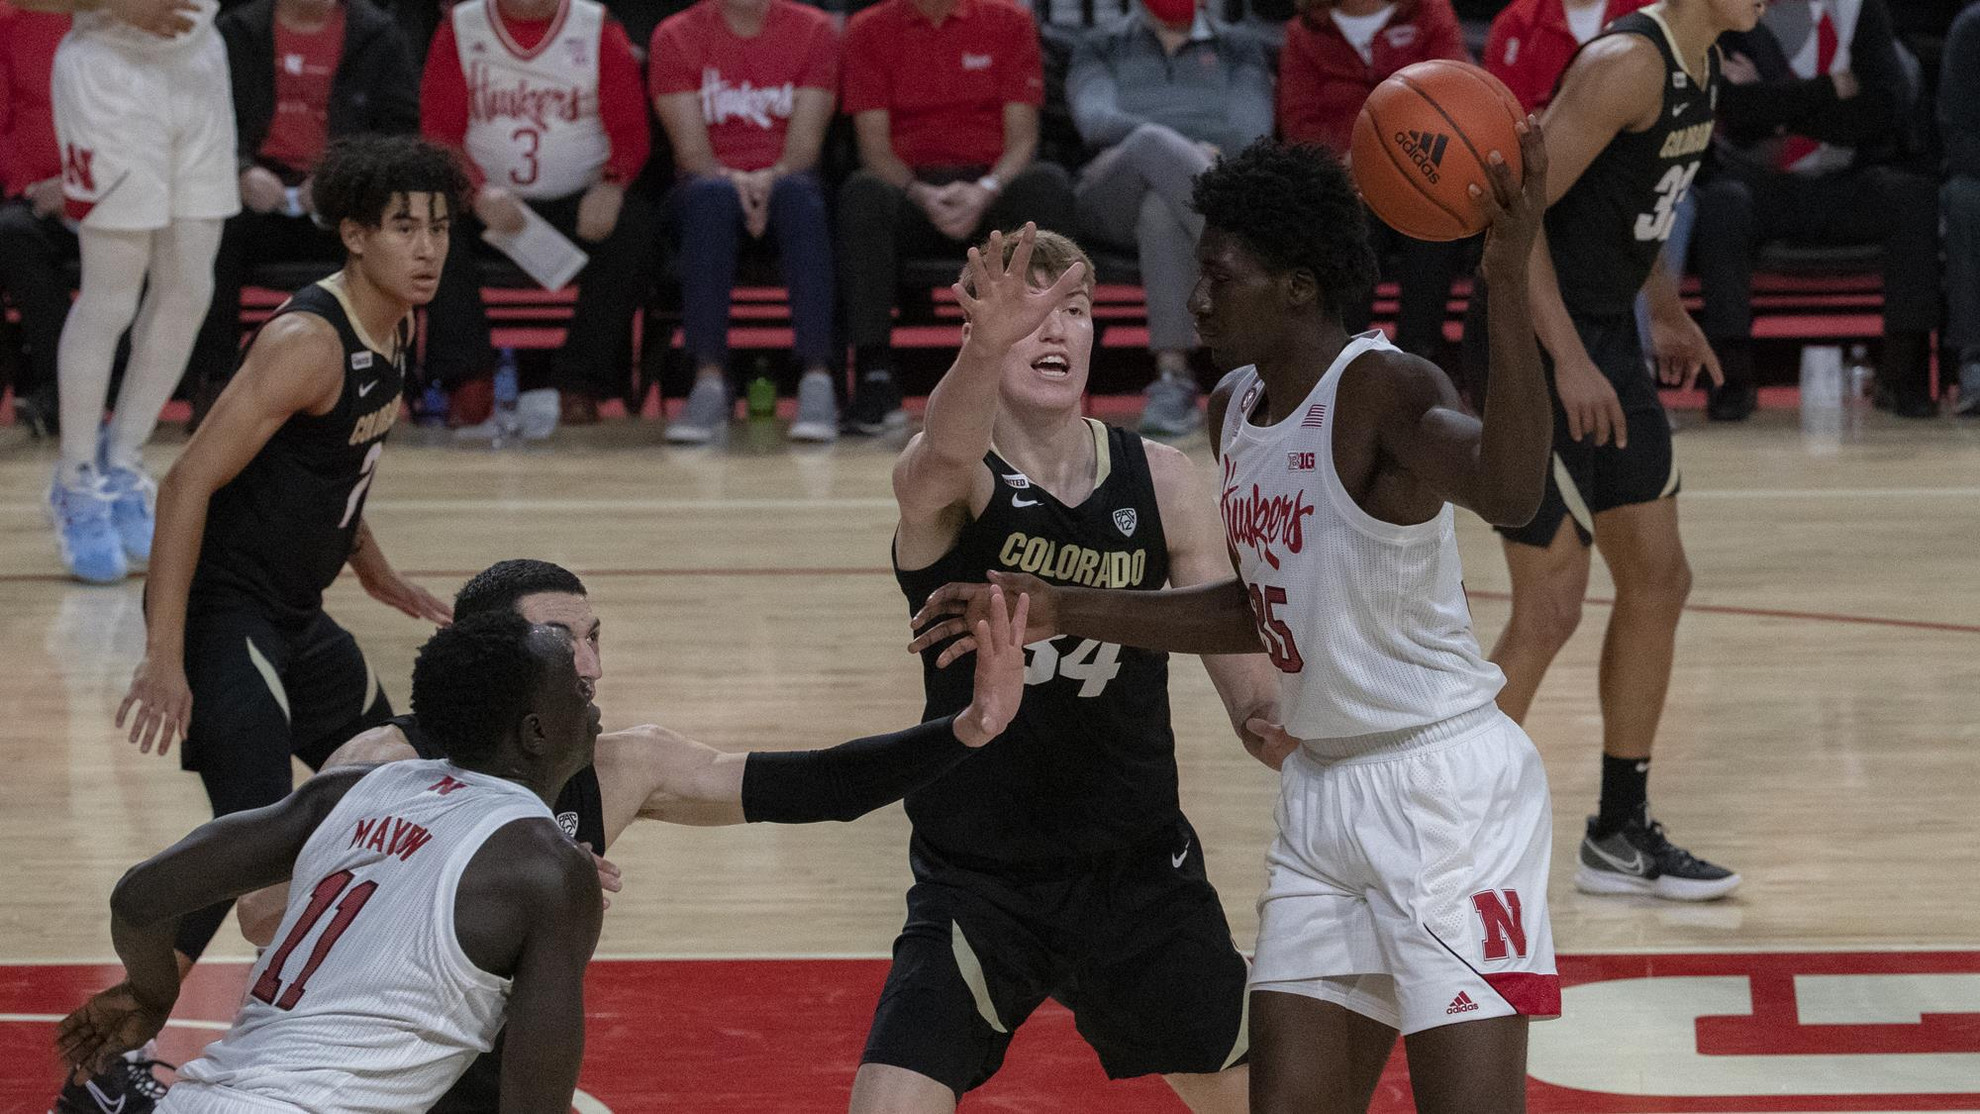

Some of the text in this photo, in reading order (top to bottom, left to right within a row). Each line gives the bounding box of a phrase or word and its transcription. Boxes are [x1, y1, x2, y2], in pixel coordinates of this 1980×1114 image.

[510, 128, 538, 185] 3
[1394, 132, 1440, 185] adidas
[1114, 509, 1136, 526] PAC
[1120, 520, 1133, 531] 12
[1220, 453, 1314, 571] Huskers
[998, 531, 1146, 589] COLORADO
[250, 868, 379, 1011] 11
[1469, 888, 1527, 962] N
[1446, 1002, 1479, 1015] adidas
